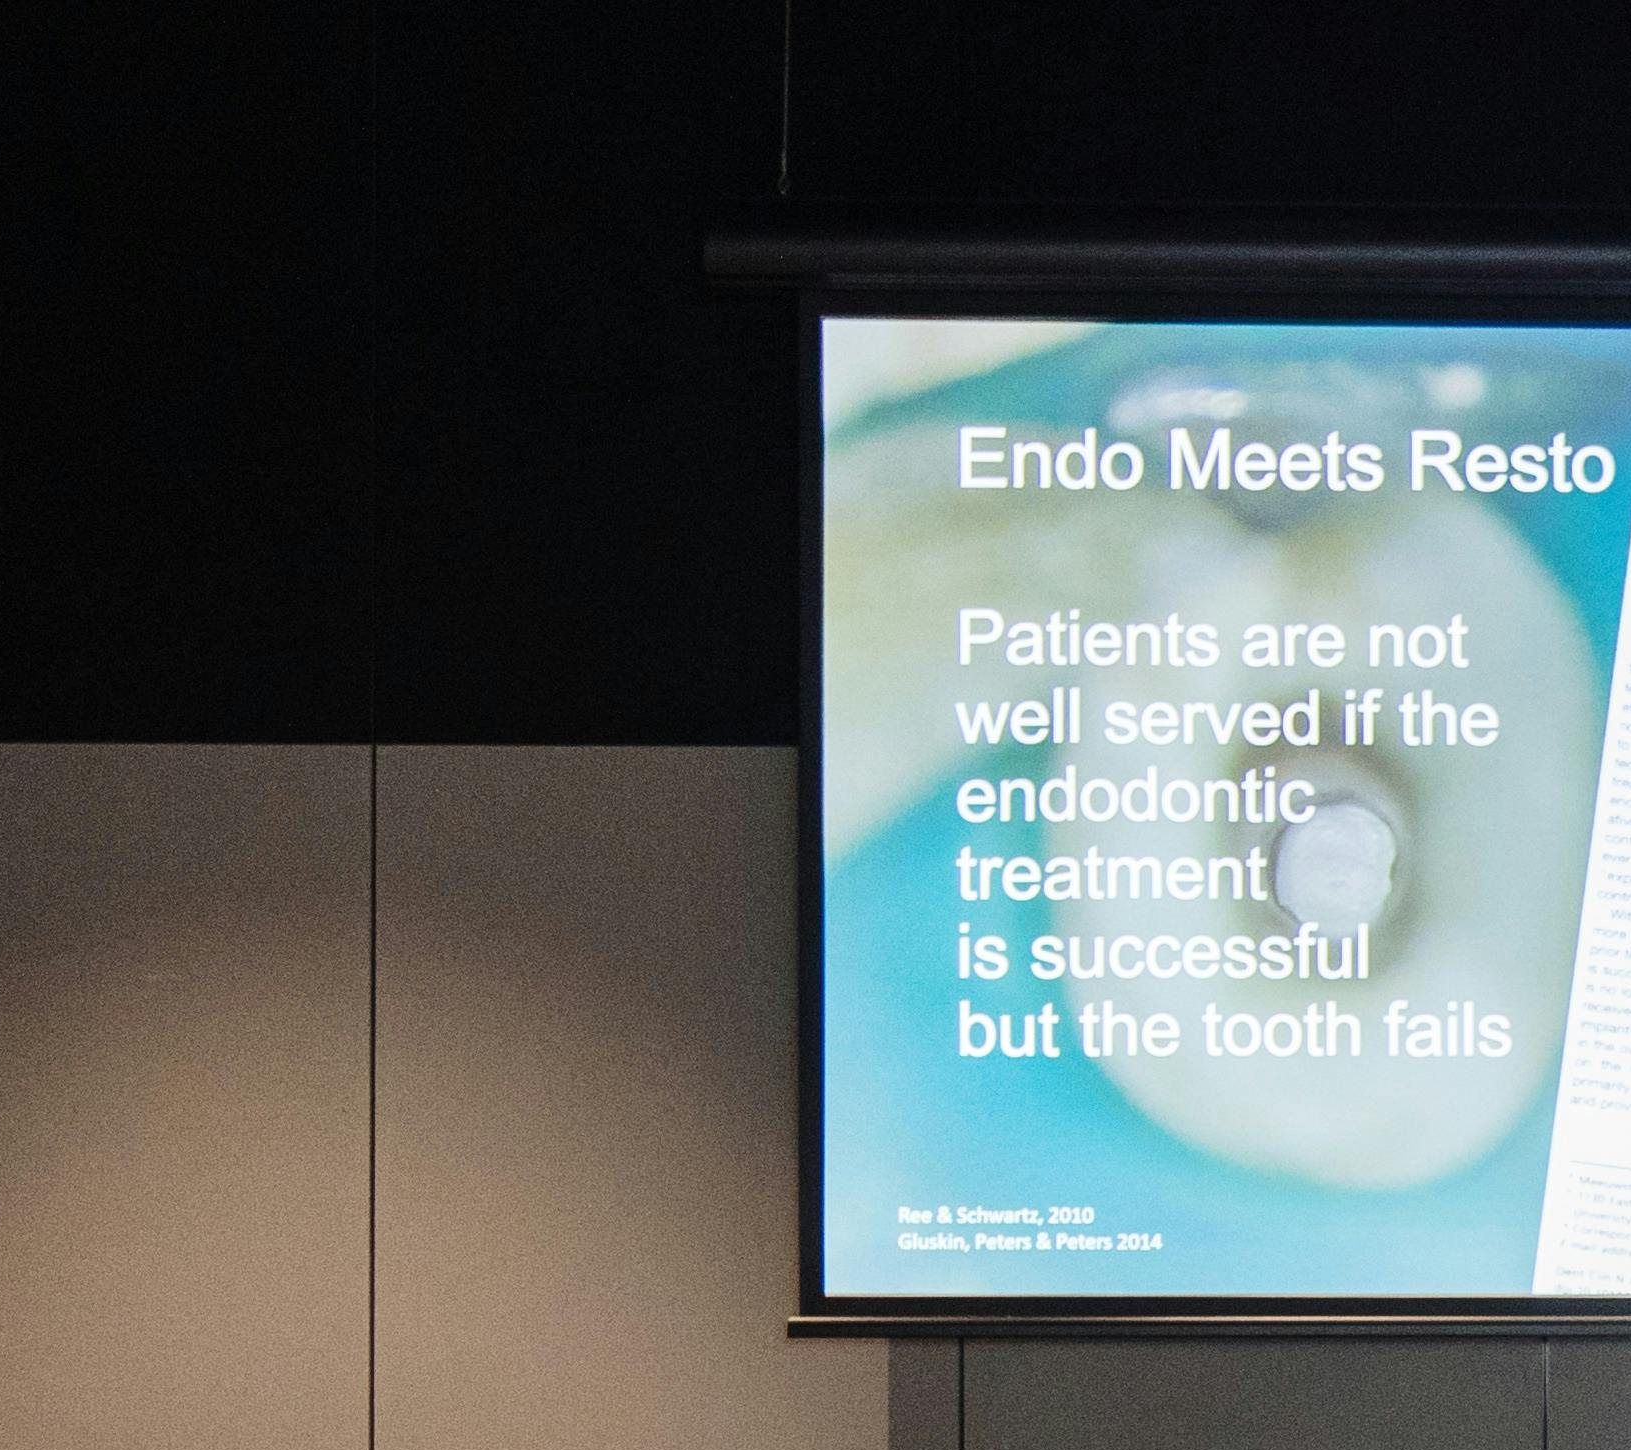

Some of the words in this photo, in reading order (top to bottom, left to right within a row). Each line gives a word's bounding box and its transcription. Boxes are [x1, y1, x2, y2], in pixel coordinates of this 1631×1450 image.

[959, 426, 1144, 491] Endo
[1170, 428, 1384, 492] Meets
[1411, 429, 1615, 494] Resto
[959, 608, 1219, 667] Patients
[1242, 622, 1346, 667] are
[1367, 613, 1469, 668] not
[956, 686, 1080, 745] well
[1104, 688, 1319, 746] served
[1343, 689, 1379, 745] if
[1398, 689, 1499, 747] the
[957, 767, 1316, 824] endodontic
[957, 848, 1267, 901] treatment
[958, 923, 1008, 980] is
[1031, 923, 1369, 981] successful
[959, 1001, 1059, 1058] but
[1078, 1002, 1180, 1058] the
[1203, 1002, 1361, 1058] tooth
[1384, 1000, 1512, 1058] fails
[898, 1207, 931, 1224] Ree
[936, 1207, 953, 1224] &
[959, 1207, 1043, 1228] Schwartz,
[1048, 1207, 1095, 1224] 2010
[898, 1234, 970, 1255] Gluskin,
[976, 1234, 1031, 1251] Peters
[1036, 1234, 1052, 1251] &
[1057, 1234, 1111, 1251] Peters
[1117, 1234, 1163, 1251] 2014
